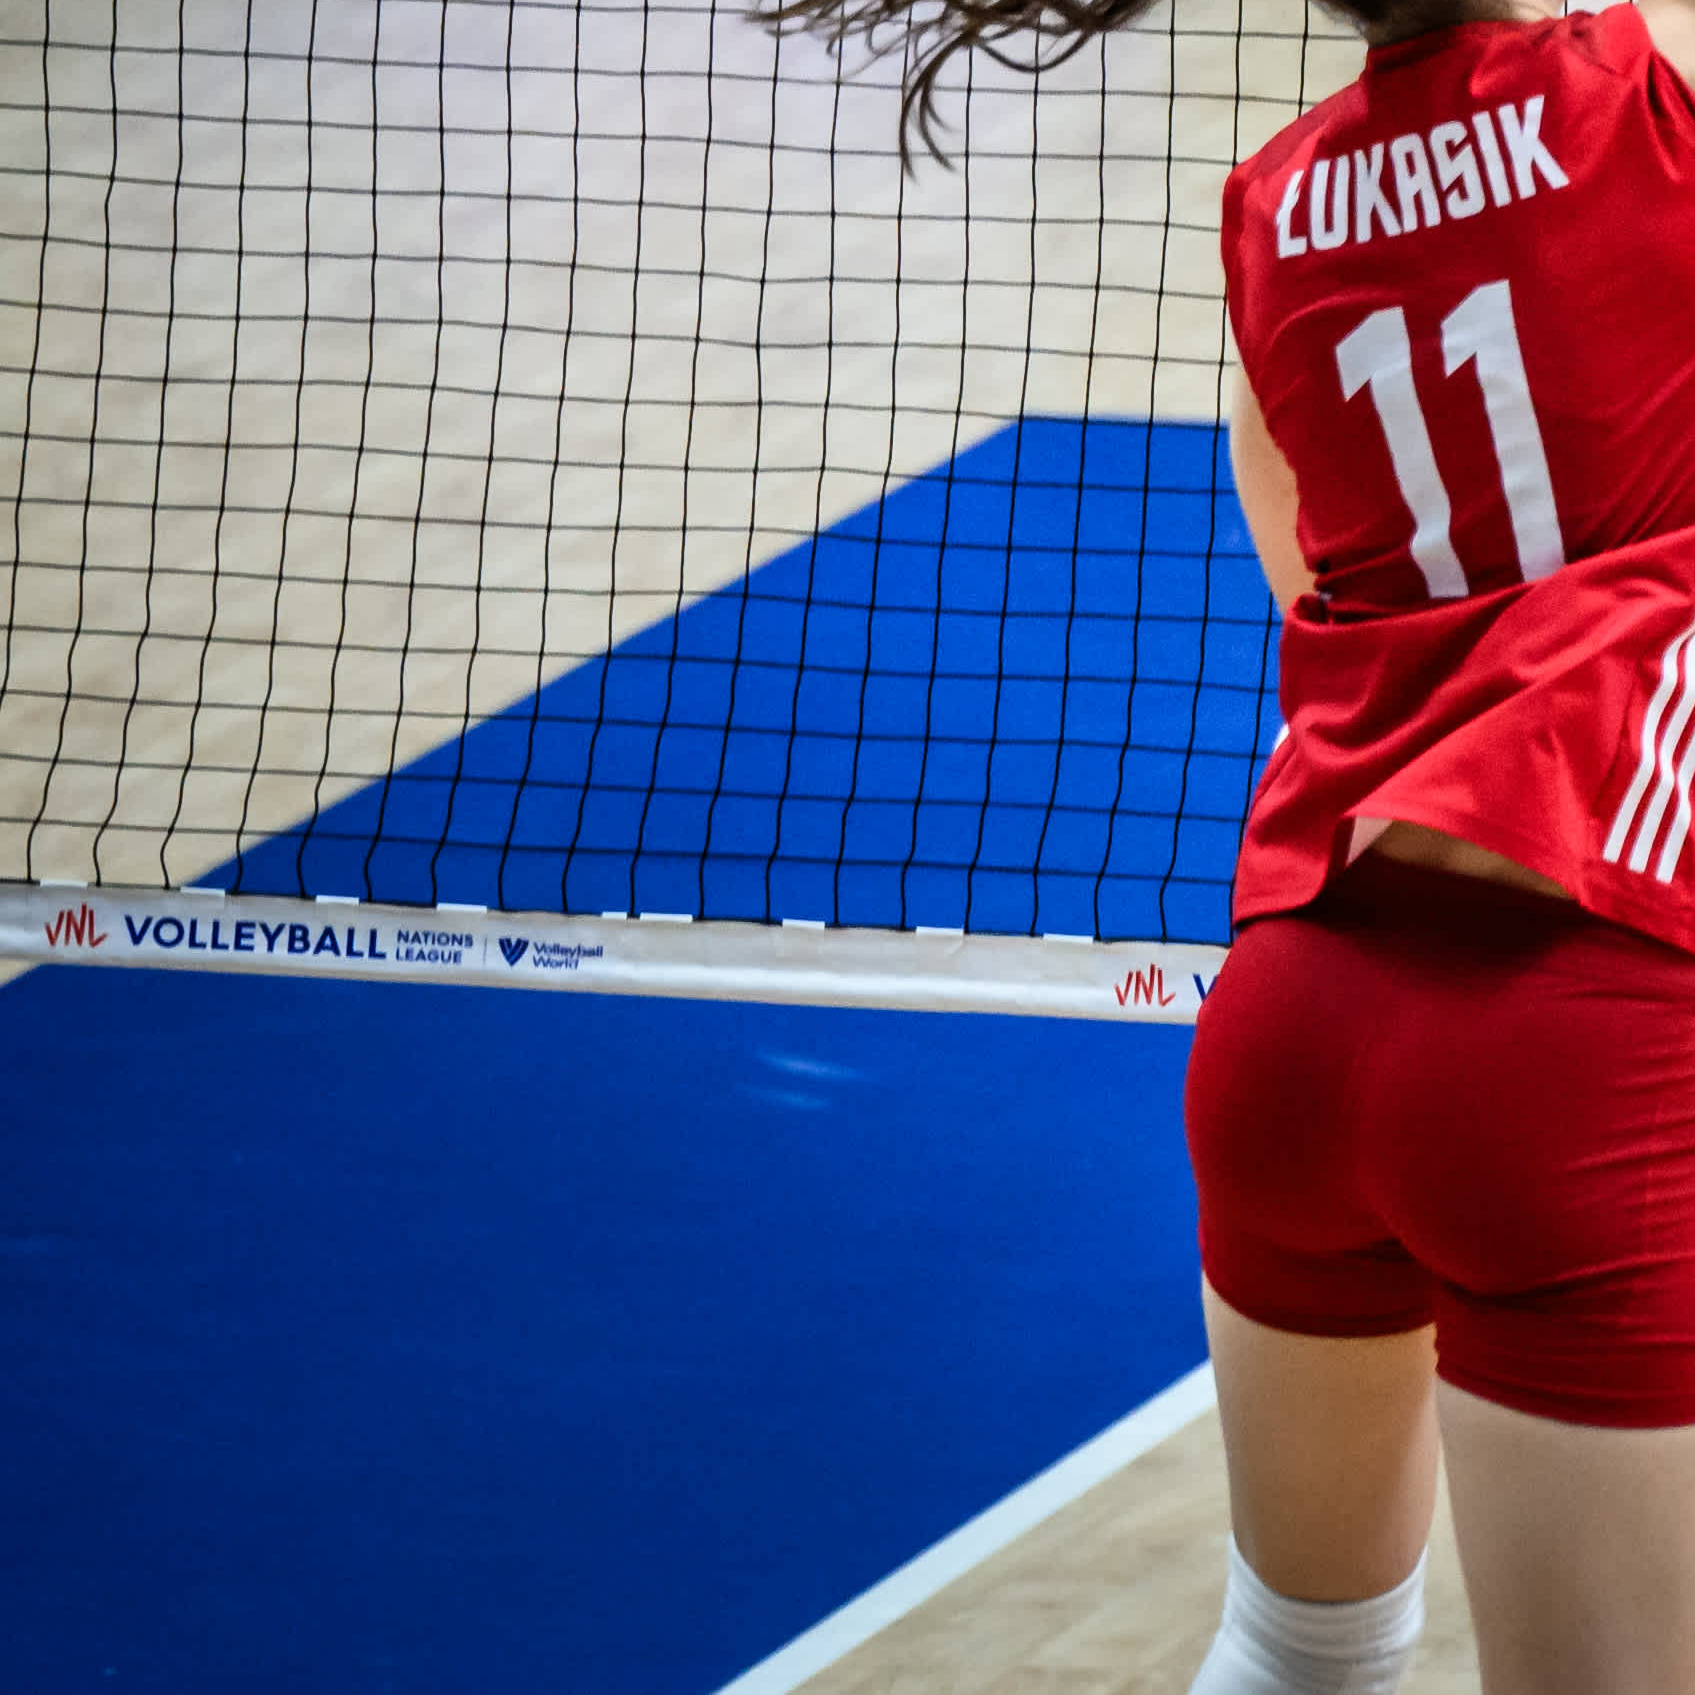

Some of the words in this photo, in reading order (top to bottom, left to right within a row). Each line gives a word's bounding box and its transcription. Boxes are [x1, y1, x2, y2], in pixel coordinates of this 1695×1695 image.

[1335, 279, 1566, 598] 11
[45, 902, 108, 948] VNL
[124, 913, 387, 960] VOLLEYBALL
[397, 929, 473, 948] NATIONS
[396, 948, 463, 965] LEAGUE
[533, 941, 604, 959] Volleyball
[532, 955, 580, 971] World
[1114, 963, 1176, 1006] VNL
